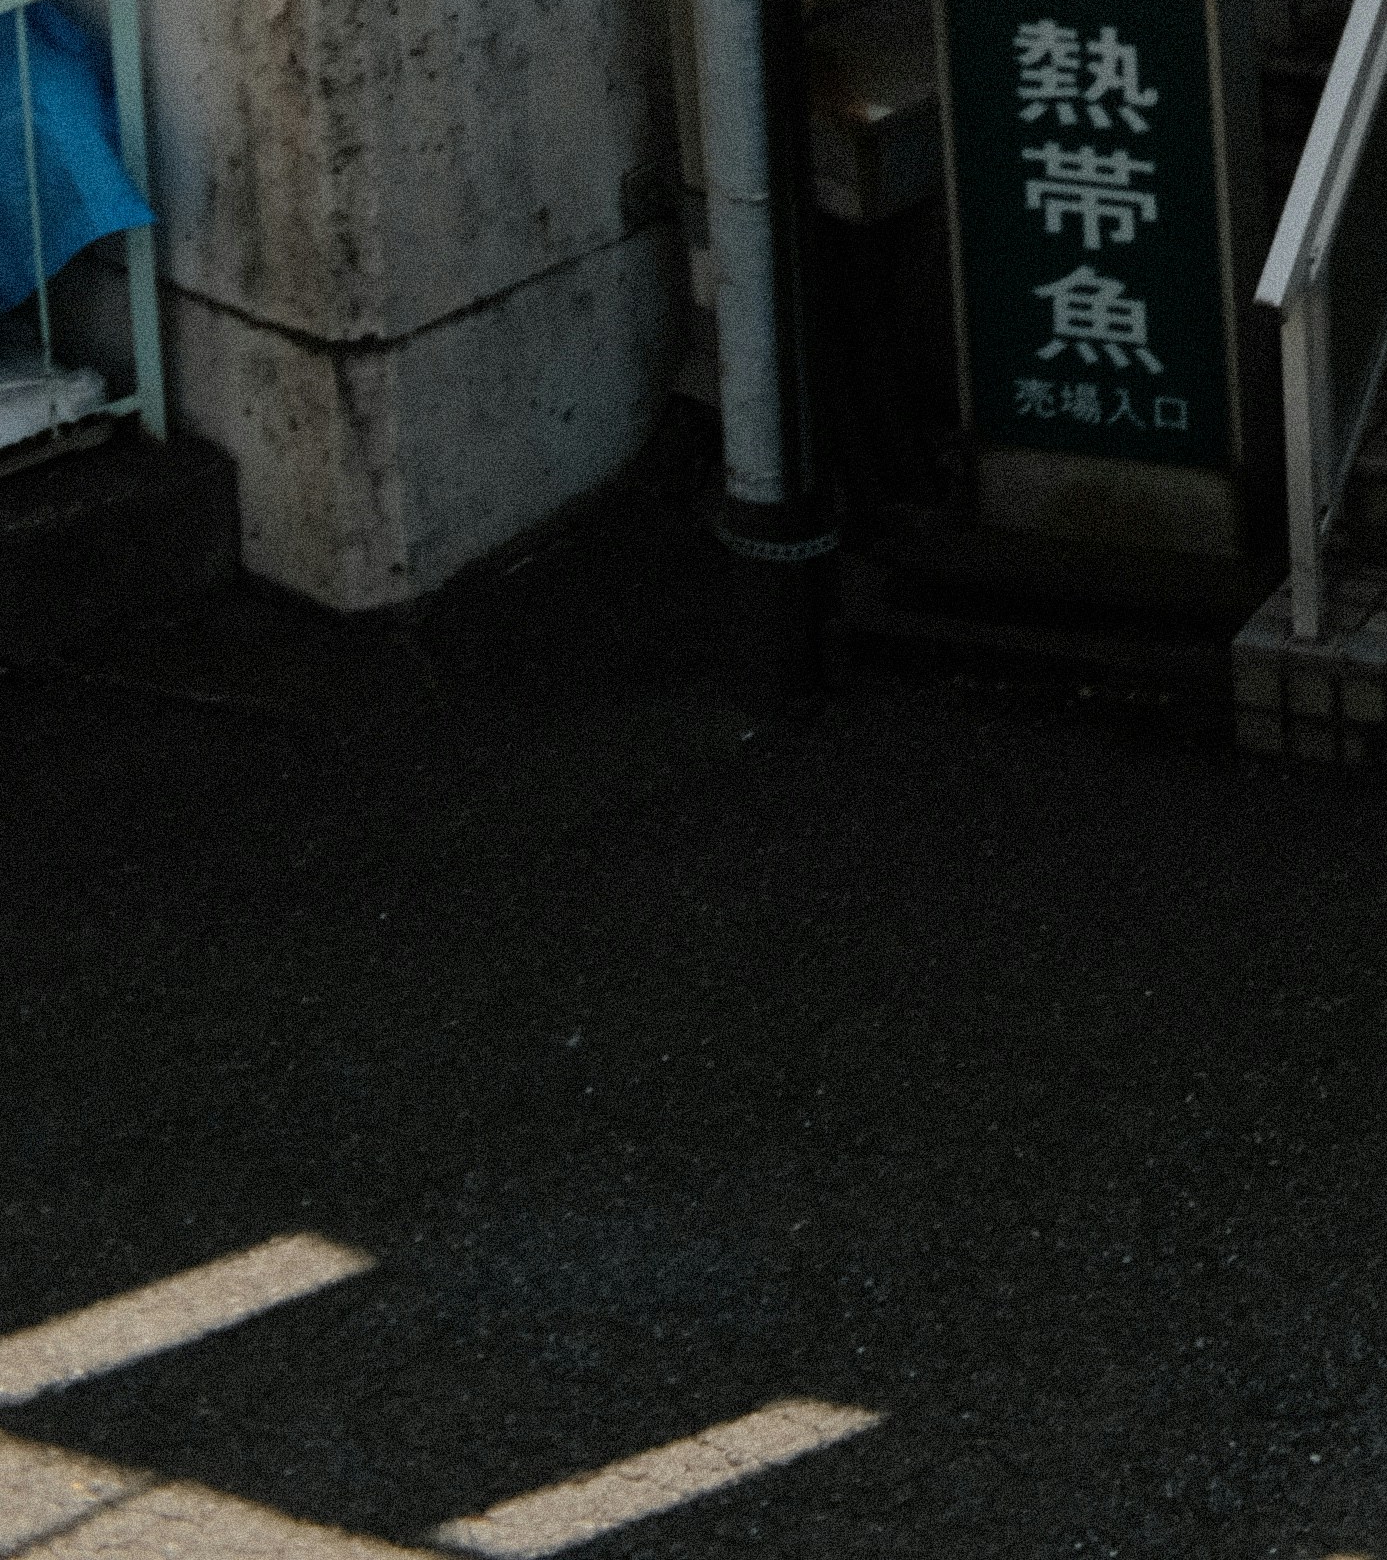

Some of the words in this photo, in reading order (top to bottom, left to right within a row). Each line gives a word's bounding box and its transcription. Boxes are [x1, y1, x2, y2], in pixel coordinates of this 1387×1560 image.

[1012, 18, 1164, 375] 熱帯魚
[1013, 377, 1190, 431] 売場入口
